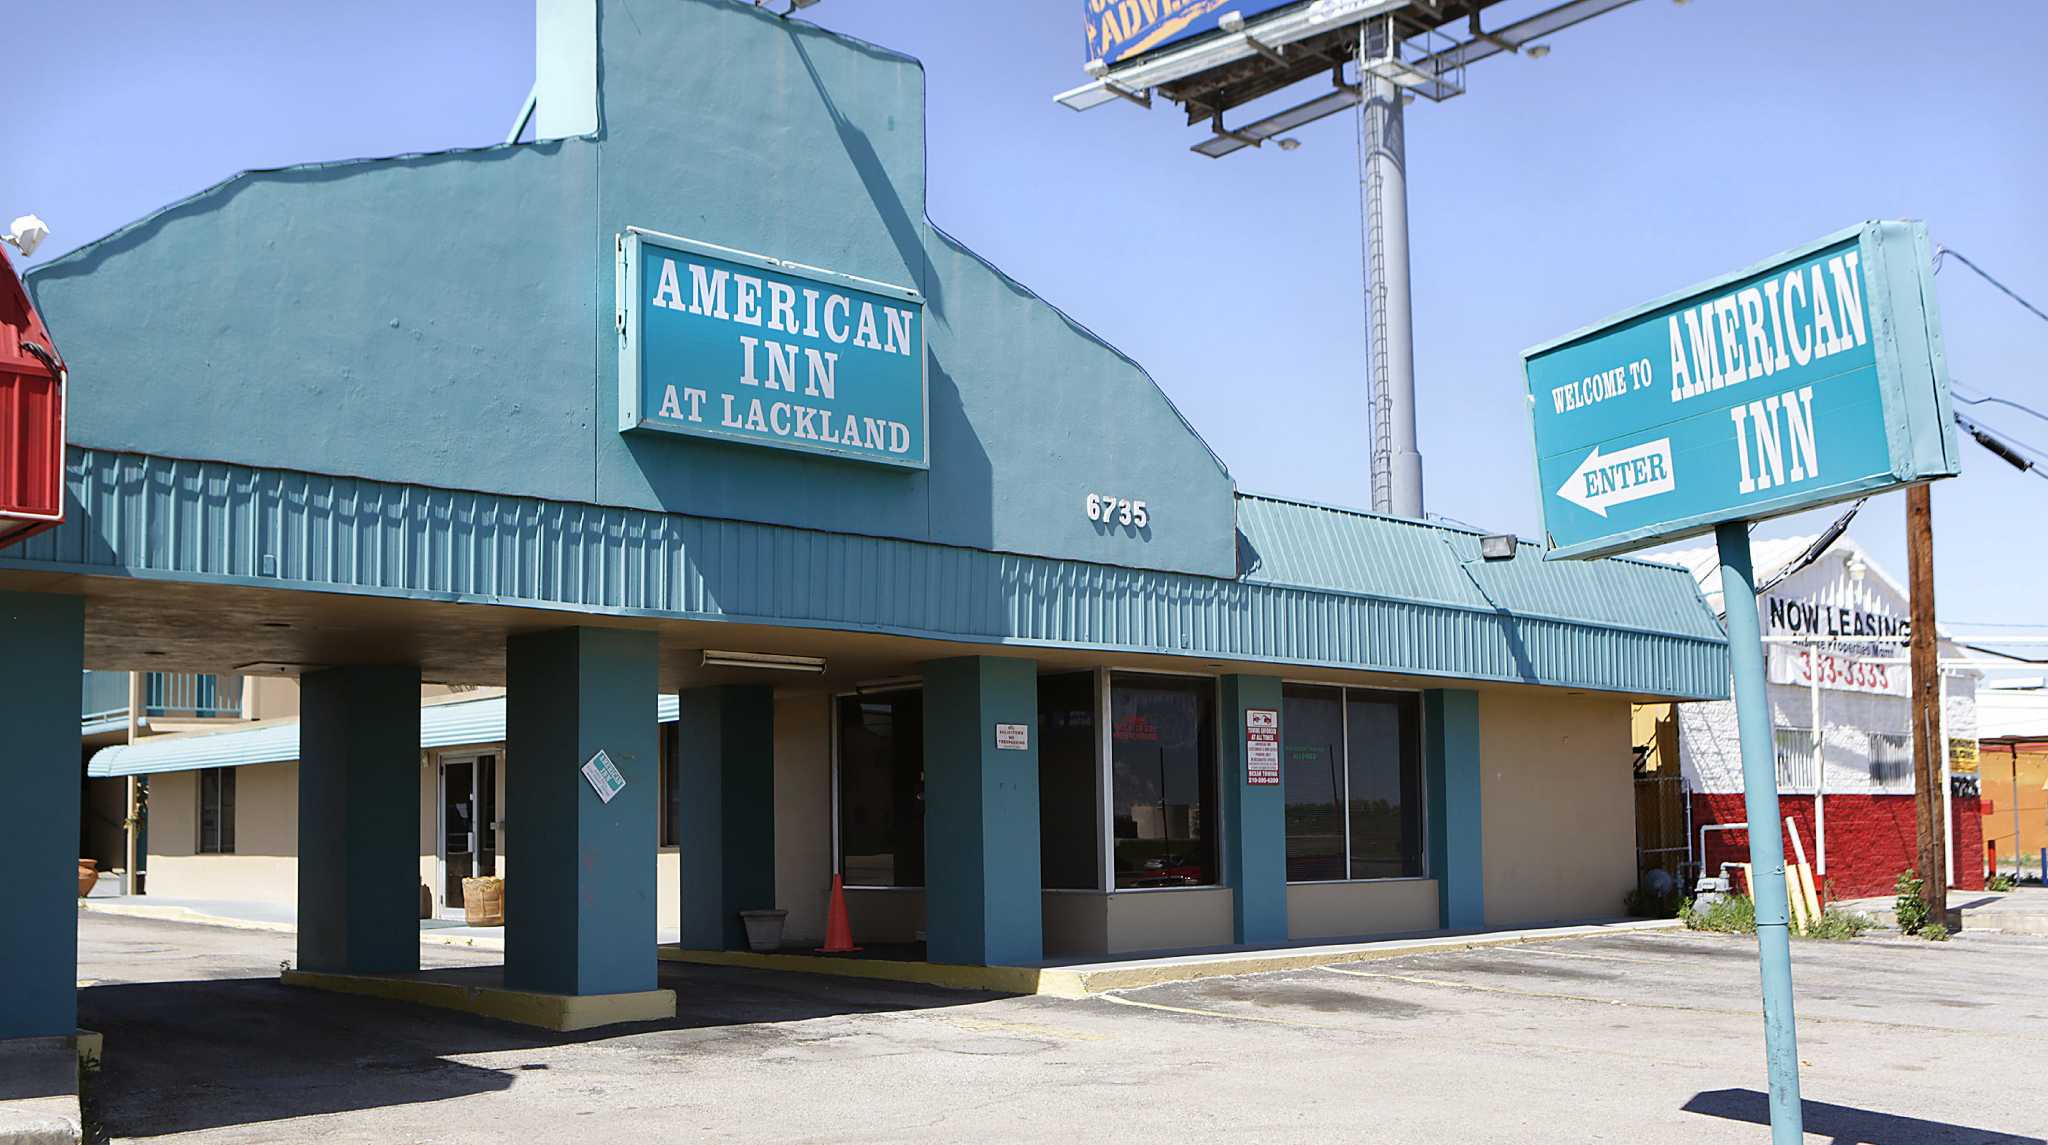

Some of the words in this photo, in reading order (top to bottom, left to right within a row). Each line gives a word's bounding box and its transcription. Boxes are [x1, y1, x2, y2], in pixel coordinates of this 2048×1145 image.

[652, 258, 913, 356] AMERICAN
[1667, 250, 1867, 403] AMERICAN
[739, 335, 839, 400] INN
[1551, 365, 1627, 415] WELCOME
[1629, 358, 1652, 390] TO
[658, 384, 706, 422] AT
[720, 393, 910, 454] LACKLAND
[1730, 386, 1819, 495] INN
[1582, 453, 1667, 499] ENTER
[1086, 493, 1147, 528] 6735
[1769, 597, 1819, 634] NOW
[1826, 607, 1911, 647] LEASING
